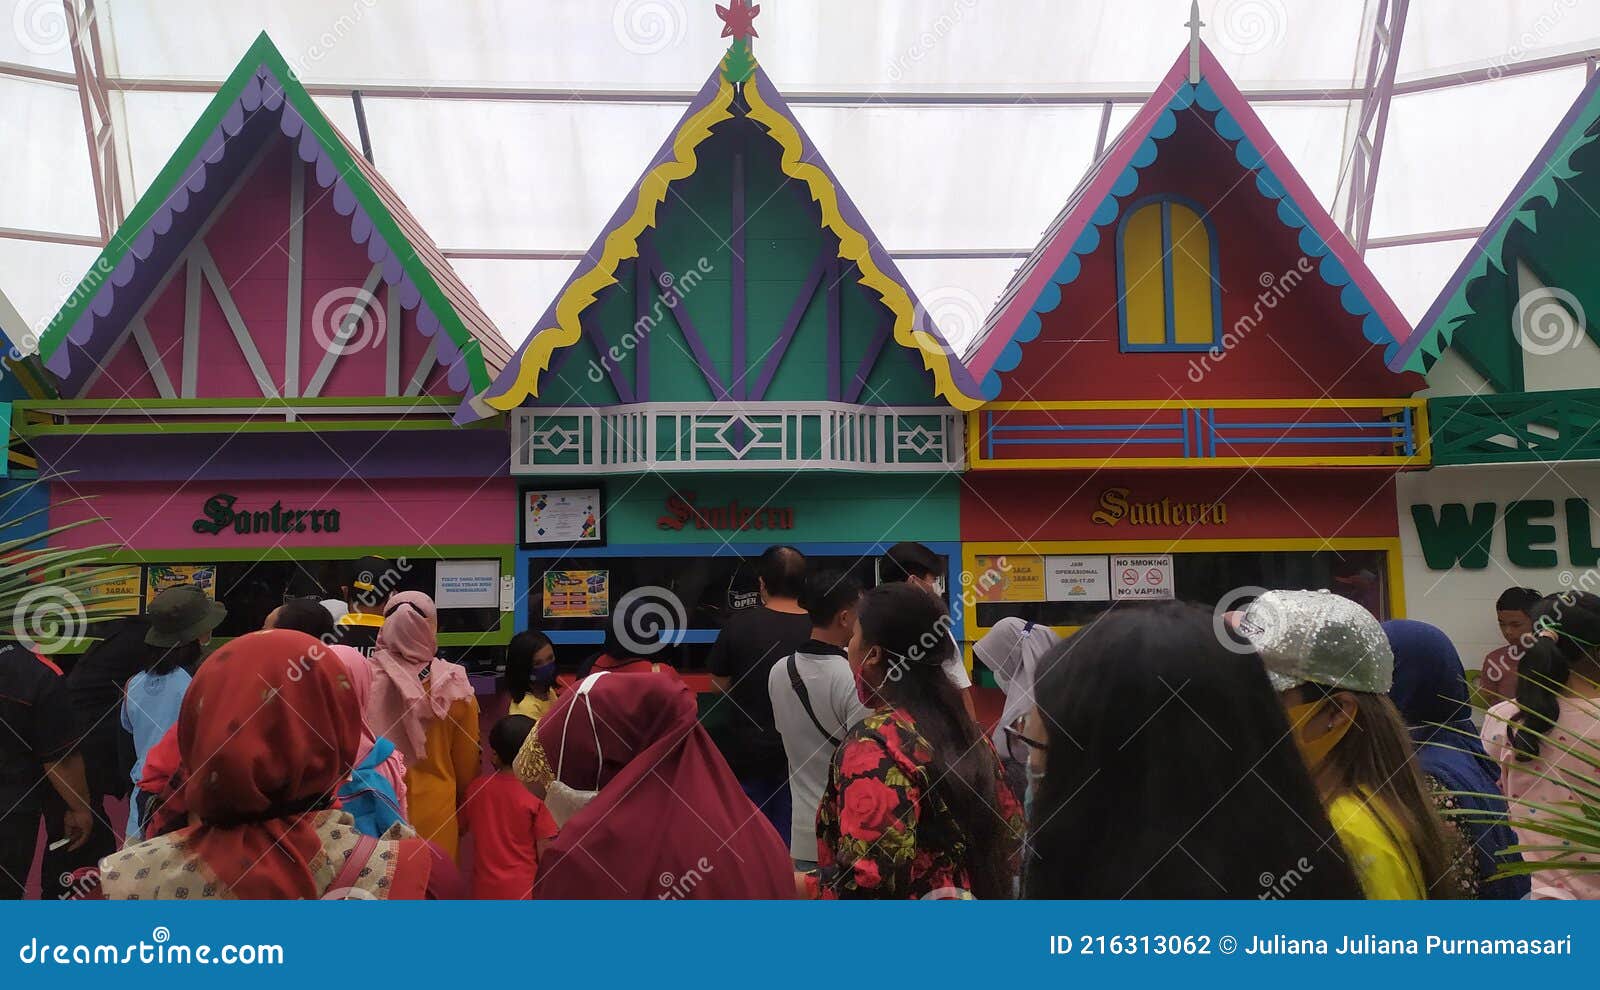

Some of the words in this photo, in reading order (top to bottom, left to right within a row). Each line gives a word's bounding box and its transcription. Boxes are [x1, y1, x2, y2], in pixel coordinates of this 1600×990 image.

[192, 493, 341, 535] Santerra
[656, 492, 795, 531] Santerra
[1091, 487, 1228, 527] Santerra
[1410, 497, 1600, 570] WEL
[734, 597, 757, 608] OPEN
